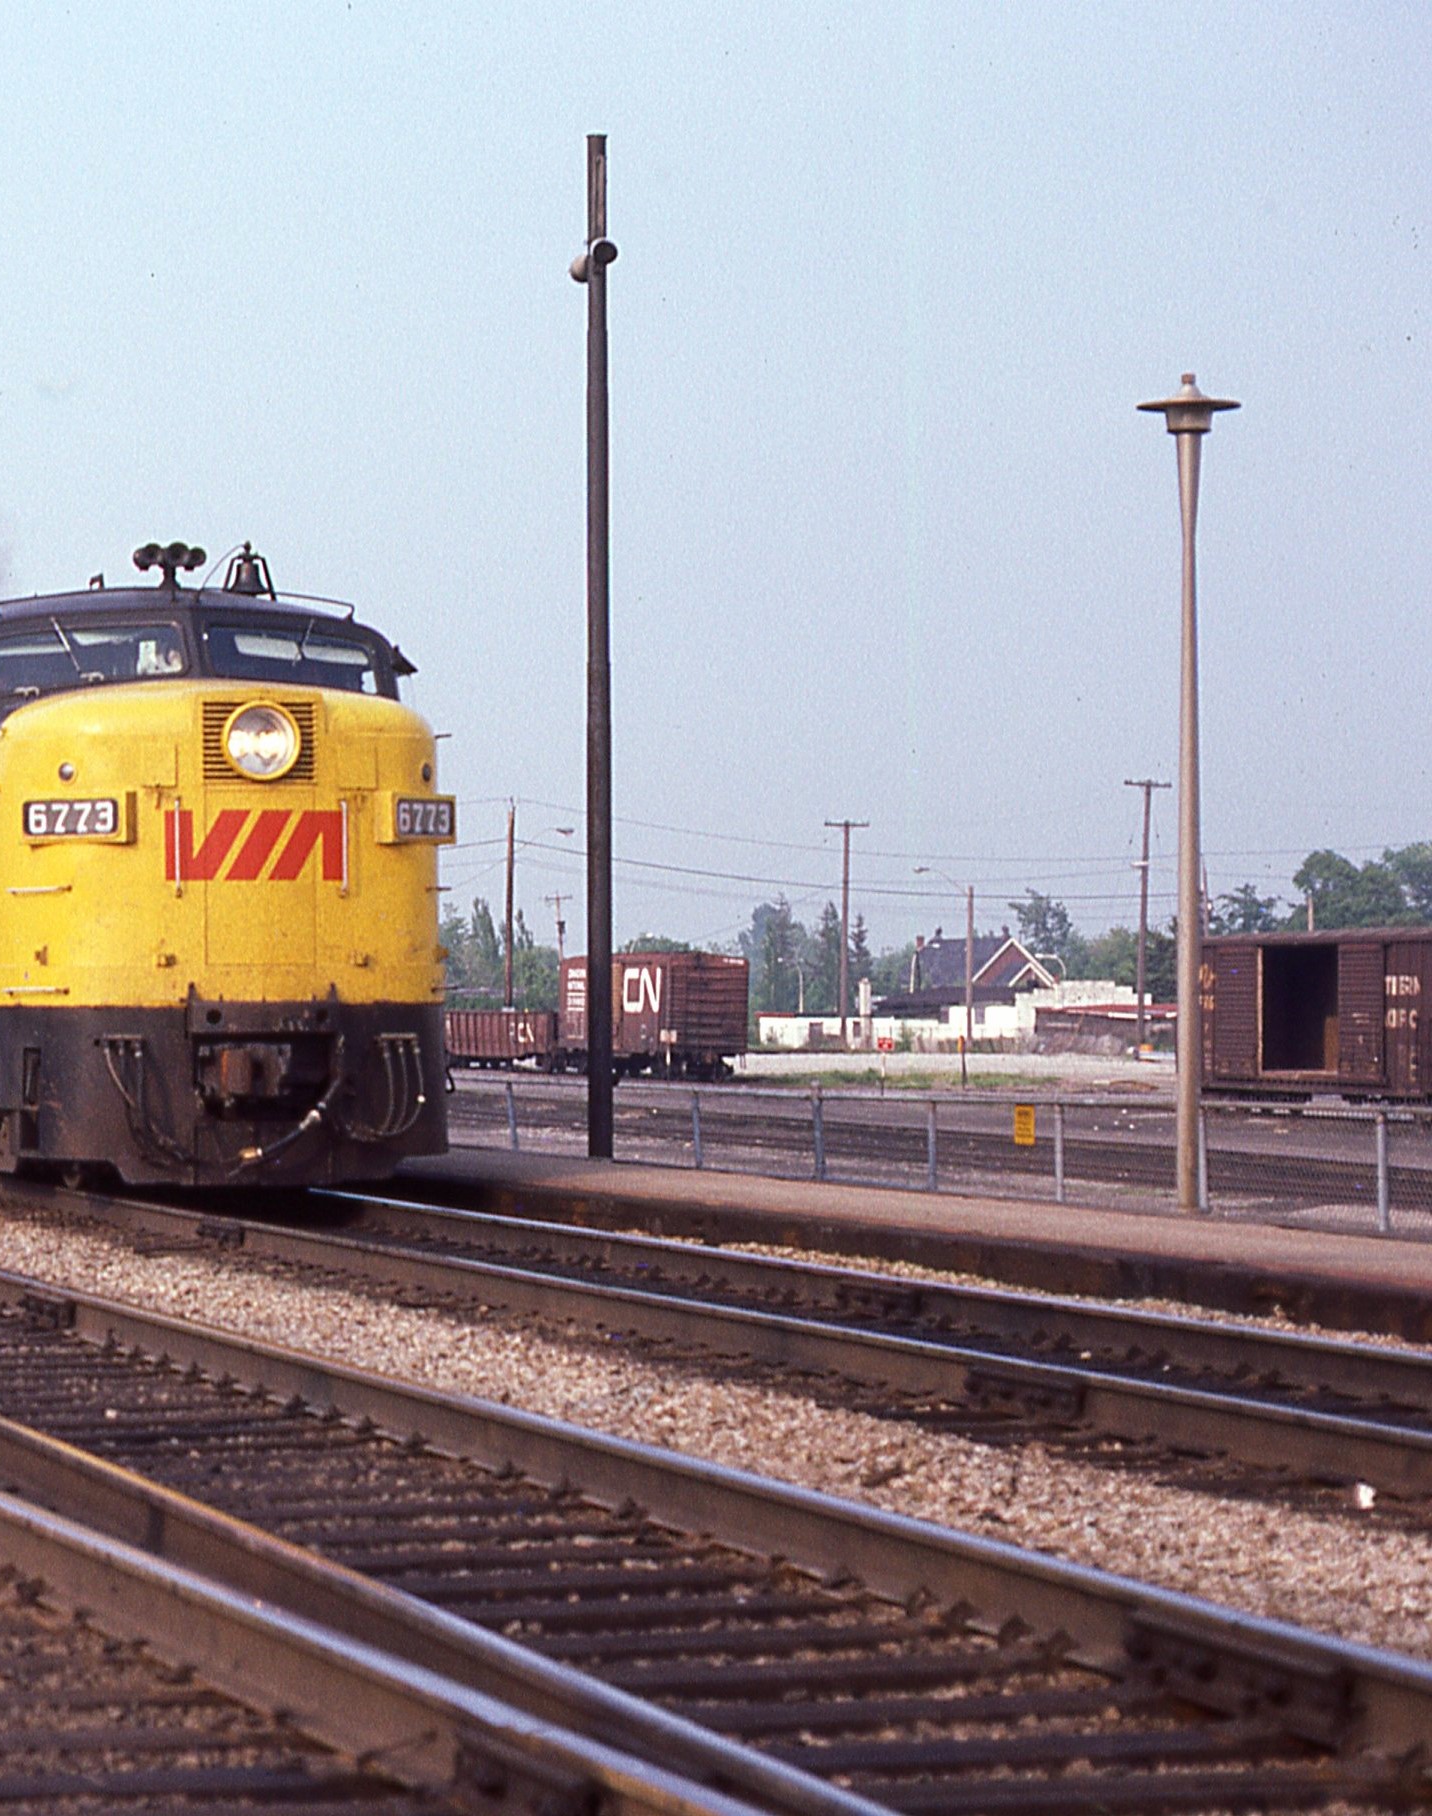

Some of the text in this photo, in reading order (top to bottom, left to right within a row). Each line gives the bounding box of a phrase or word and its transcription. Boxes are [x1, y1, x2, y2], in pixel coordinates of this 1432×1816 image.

[27, 801, 114, 834] 6773
[398, 802, 451, 834] 6773
[164, 809, 345, 881] VIA
[623, 966, 662, 1013] CN
